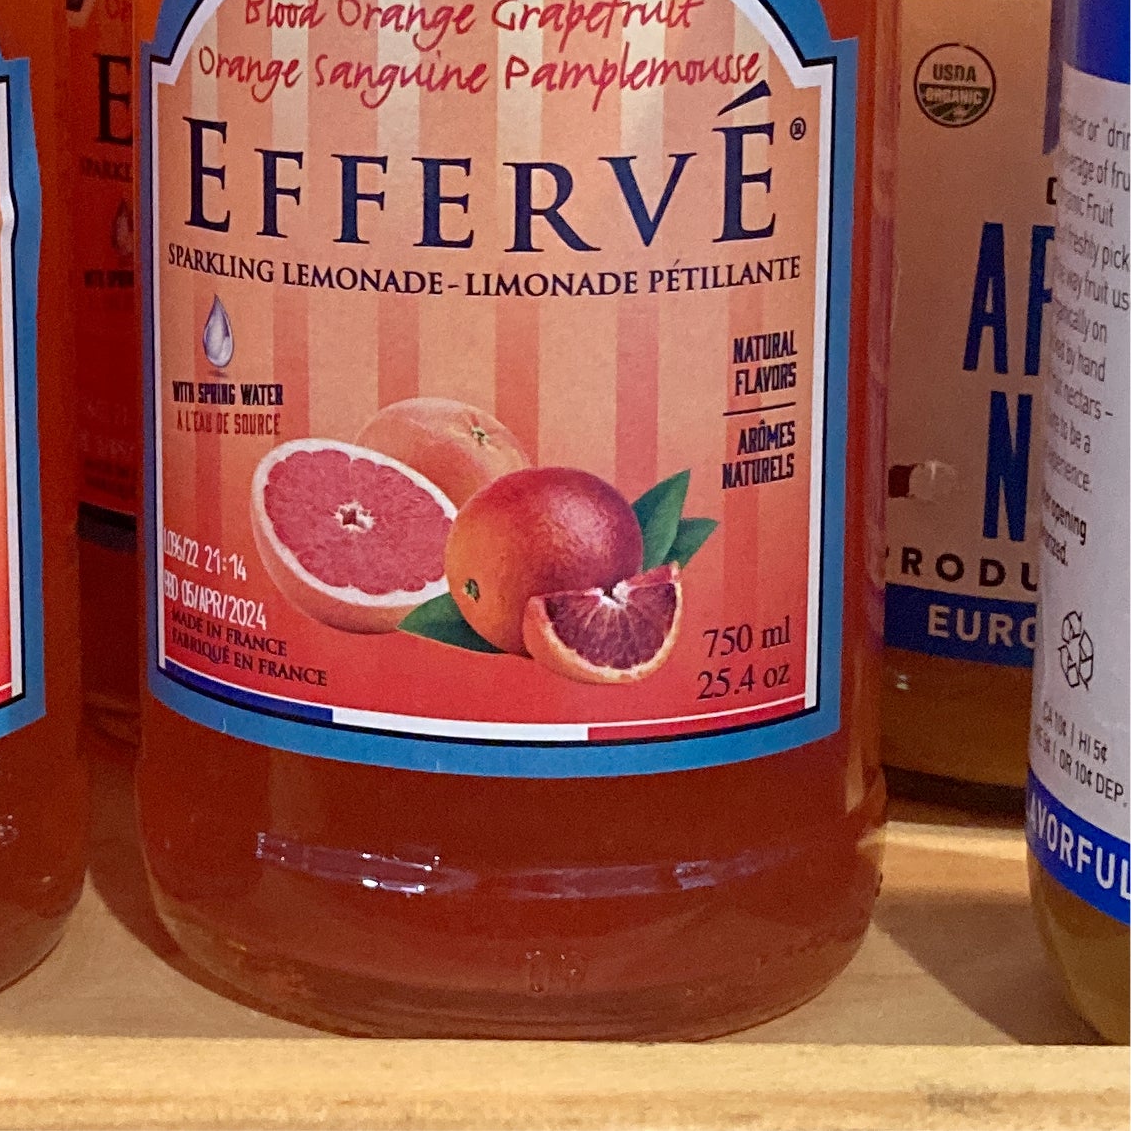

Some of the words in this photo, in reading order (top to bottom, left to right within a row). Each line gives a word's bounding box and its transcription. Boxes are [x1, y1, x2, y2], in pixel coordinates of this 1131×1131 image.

[198, 45, 302, 103] Orange
[315, 55, 489, 110] Sanguine
[505, 42, 762, 111] Pamplemousse
[933, 63, 976, 82] USDA
[1086, 192, 1115, 228] Fruit
[168, 242, 275, 283] SPARKLING
[282, 263, 442, 296] LEMONADE
[464, 266, 638, 297] LIMONADE
[648, 255, 801, 294] PÉTILLANTE
[1084, 270, 1109, 306] fruit
[733, 330, 797, 364] NATURAL
[1092, 320, 1108, 344] on
[735, 361, 797, 396] FLAVORS
[1077, 345, 1106, 383] hand
[172, 380, 195, 403] WITH
[198, 382, 235, 405] SPRING
[240, 383, 284, 406] WATER
[234, 412, 281, 436] SOURCE
[737, 418, 796, 456] ARÔMES
[1083, 435, 1091, 454] a
[722, 453, 795, 490] NATURELS
[204, 544, 247, 582] 21:14
[181, 578, 267, 631] 05/APR/2024
[170, 607, 203, 633] MADE
[206, 619, 222, 639] IN
[225, 626, 288, 657] FRANCE
[703, 623, 753, 658] 750
[760, 615, 791, 649] ml
[171, 626, 230, 664] FABRIQUÉ
[234, 651, 253, 671] EN
[257, 657, 328, 687] FRANCE
[697, 664, 755, 700] 25.4
[763, 664, 790, 689] oz
